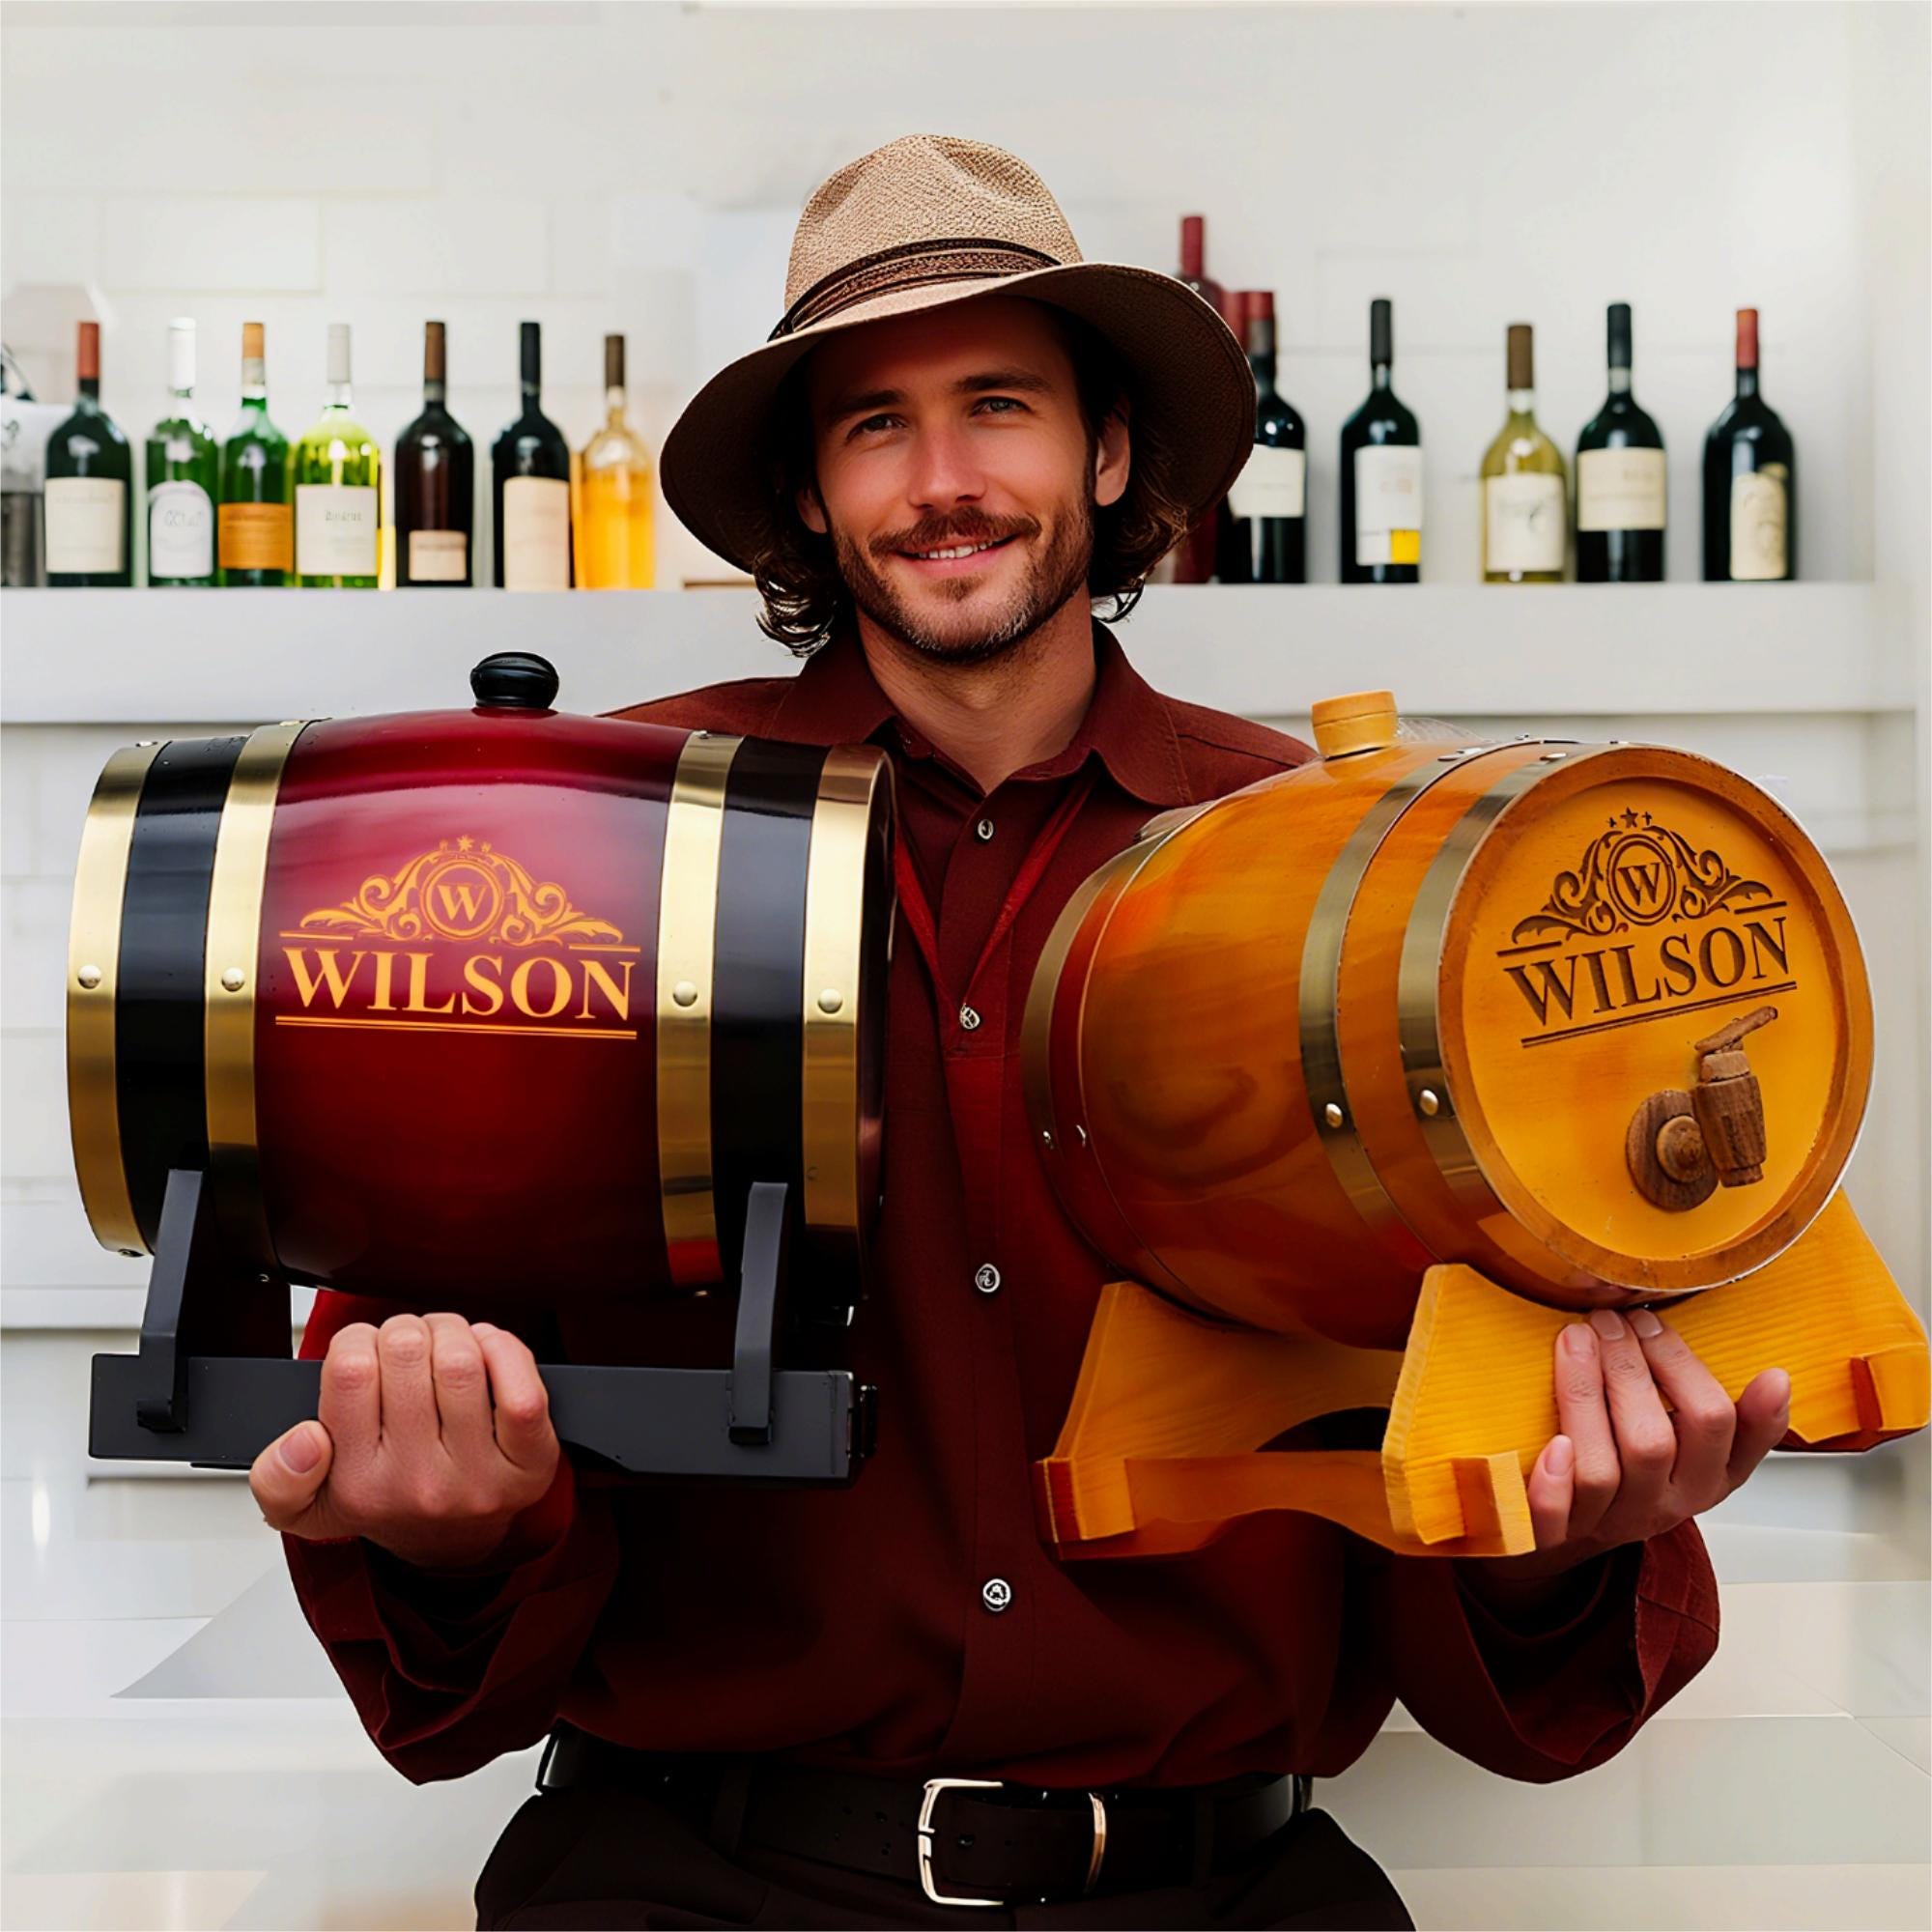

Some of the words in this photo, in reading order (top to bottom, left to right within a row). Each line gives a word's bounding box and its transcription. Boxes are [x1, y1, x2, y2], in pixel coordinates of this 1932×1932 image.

[437, 885, 488, 922] W
[1617, 862, 1662, 906] W
[282, 947, 636, 1021] WILSON
[1503, 916, 1789, 1026] WILSON
